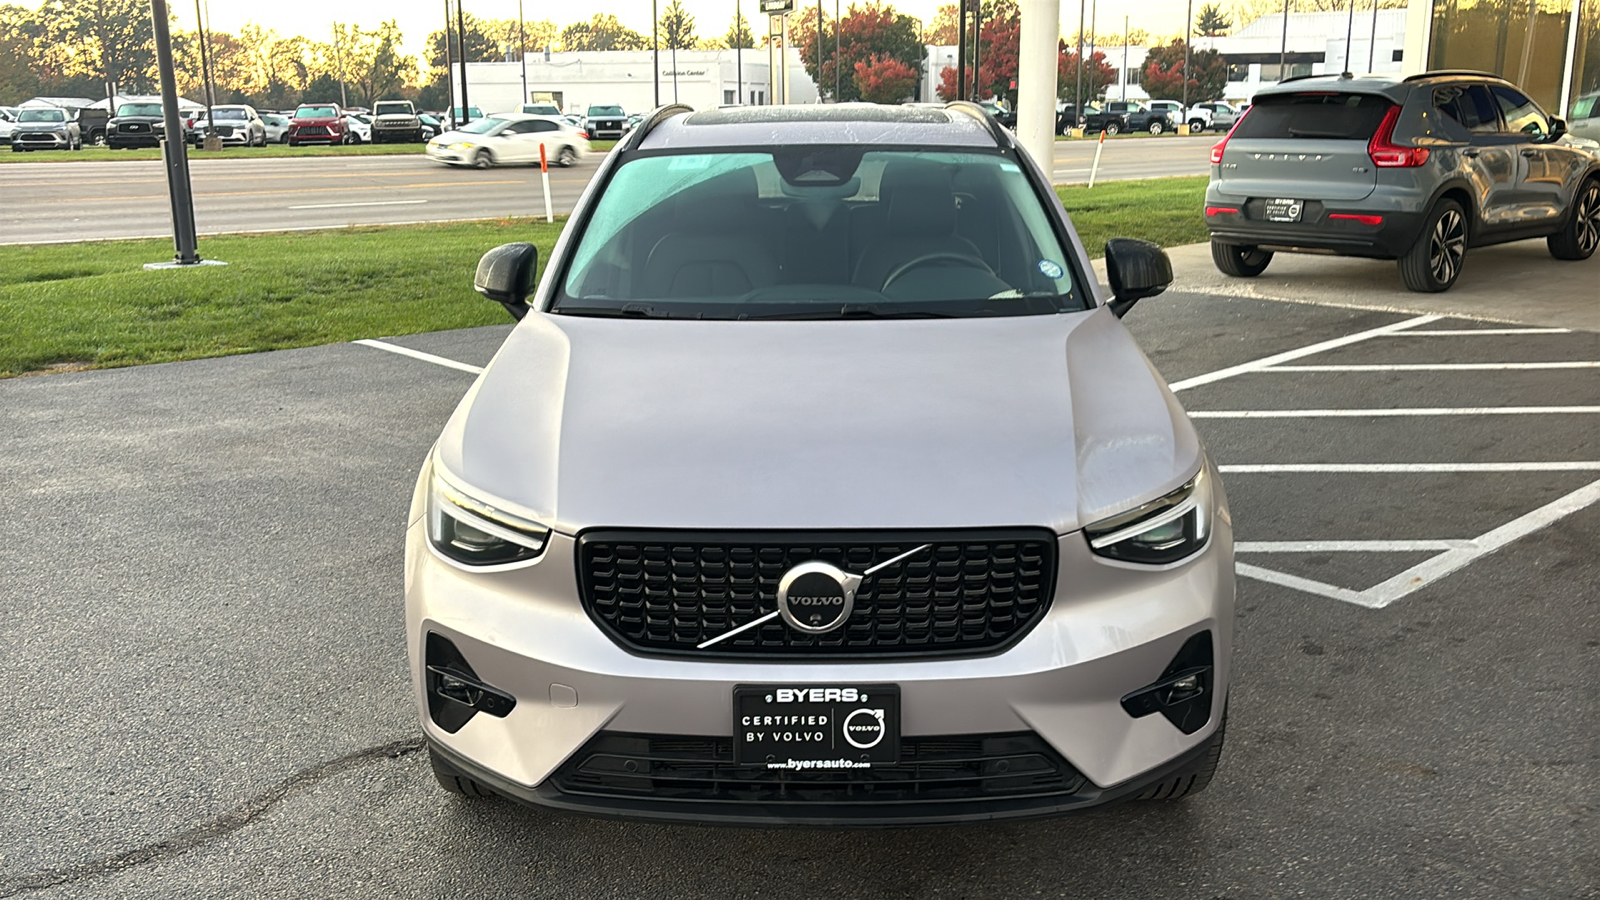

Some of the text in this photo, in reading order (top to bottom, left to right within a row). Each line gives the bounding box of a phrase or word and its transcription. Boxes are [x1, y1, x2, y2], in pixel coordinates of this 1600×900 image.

[788, 596, 843, 606] VOLVO
[776, 688, 859, 703] BYERS
[741, 715, 828, 726] CERTIFIED
[746, 732, 824, 742] BY VOLVO
[767, 758, 871, 770] www.byersauto.com
